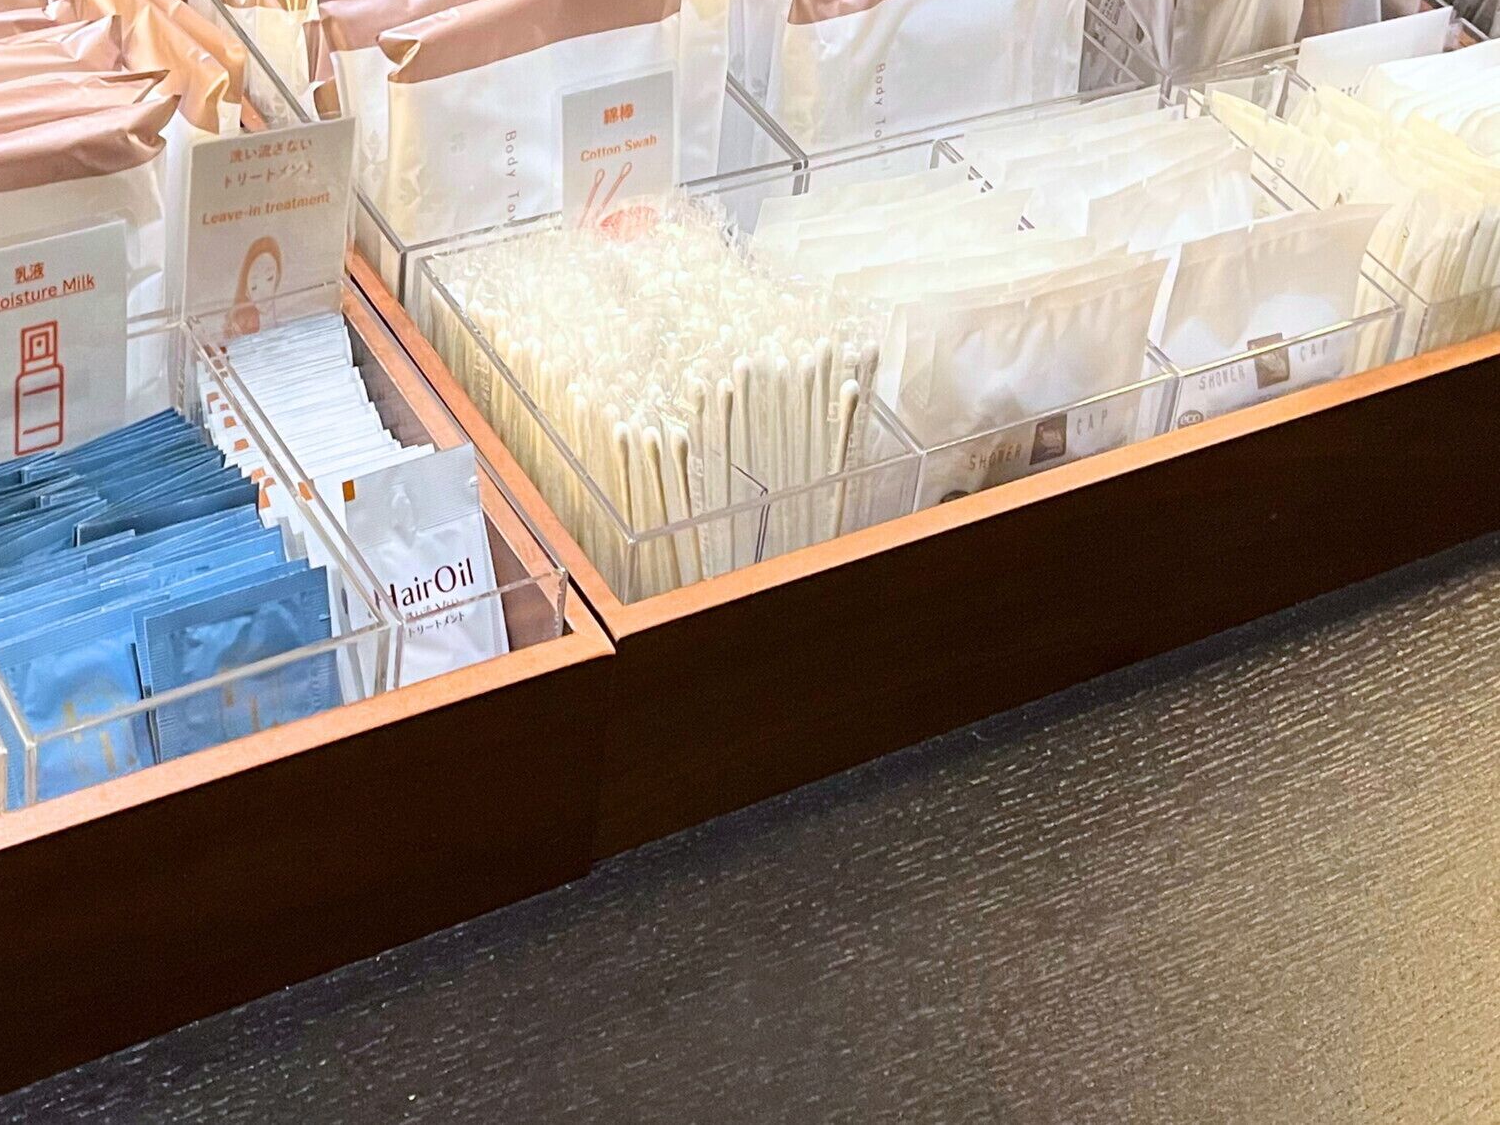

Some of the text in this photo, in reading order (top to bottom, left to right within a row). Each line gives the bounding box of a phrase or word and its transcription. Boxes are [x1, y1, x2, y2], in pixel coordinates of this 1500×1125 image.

[875, 63, 886, 105] Body
[505, 130, 518, 178] Body
[580, 145, 620, 162] Cotton
[224, 160, 314, 188] トリートメント
[202, 191, 331, 225] Leave-in treatment
[15, 262, 44, 283] 乳液
[62, 274, 96, 295] Milk
[1200, 365, 1245, 391] SHOWER
[408, 611, 465, 637] トリートメント
